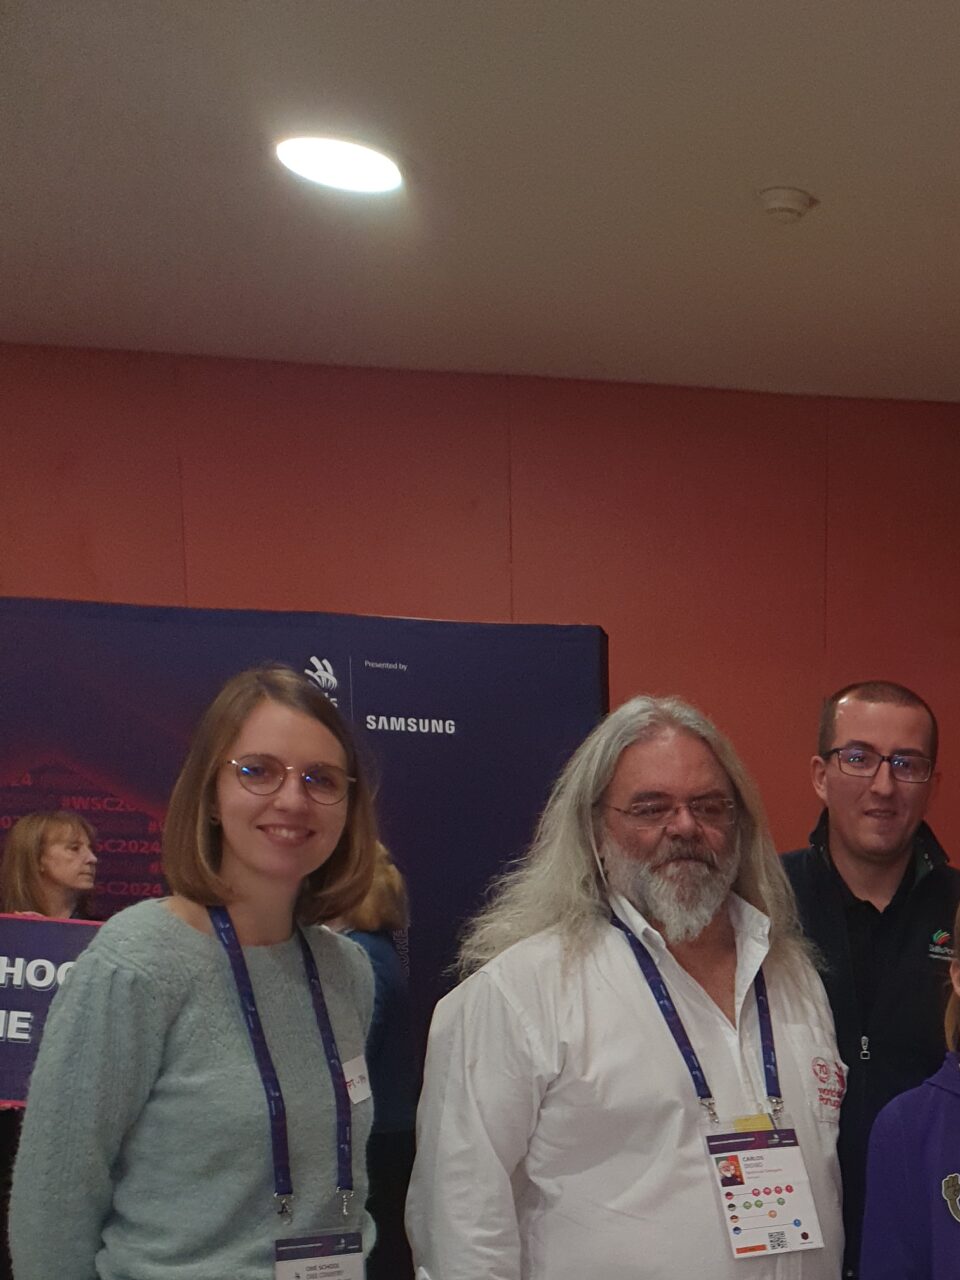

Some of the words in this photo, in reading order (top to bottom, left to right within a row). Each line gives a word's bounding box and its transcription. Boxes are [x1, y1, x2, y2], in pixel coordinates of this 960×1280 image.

[364, 660, 398, 670] Presented
[399, 663, 408, 671] by
[366, 714, 456, 734] SAMSUNG
